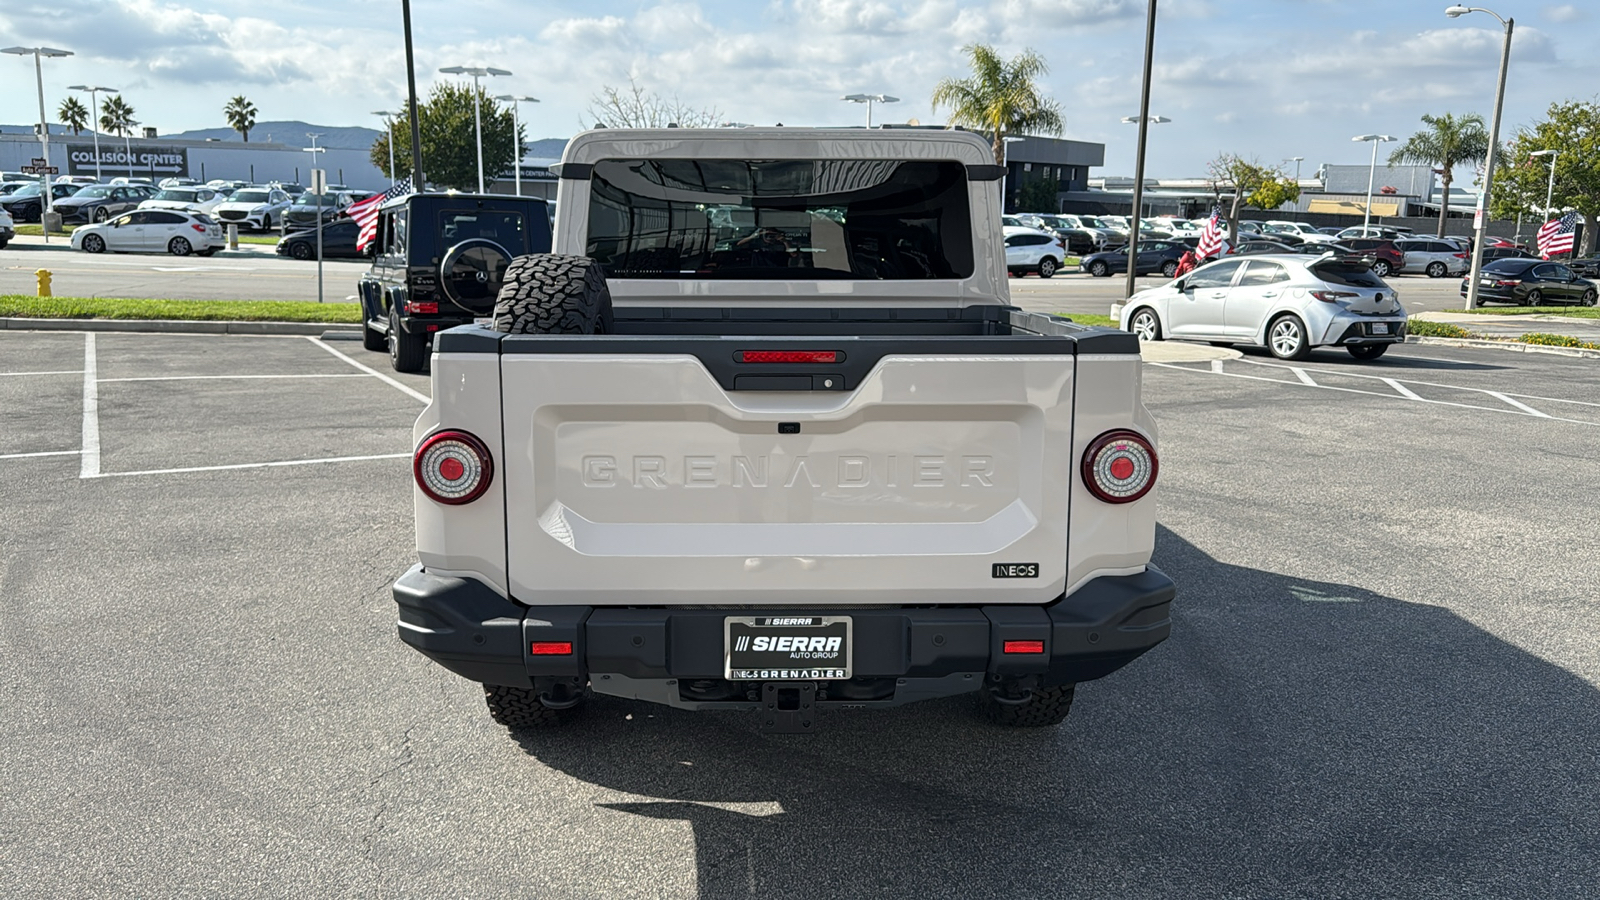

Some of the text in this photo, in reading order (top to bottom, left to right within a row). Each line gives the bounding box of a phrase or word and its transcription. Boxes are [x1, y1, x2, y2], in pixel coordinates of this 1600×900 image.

[140, 154, 184, 164] CENTER
[581, 454, 995, 490] GRENADIER
[996, 564, 1036, 577] INEOS
[752, 636, 842, 652] SIERRA
